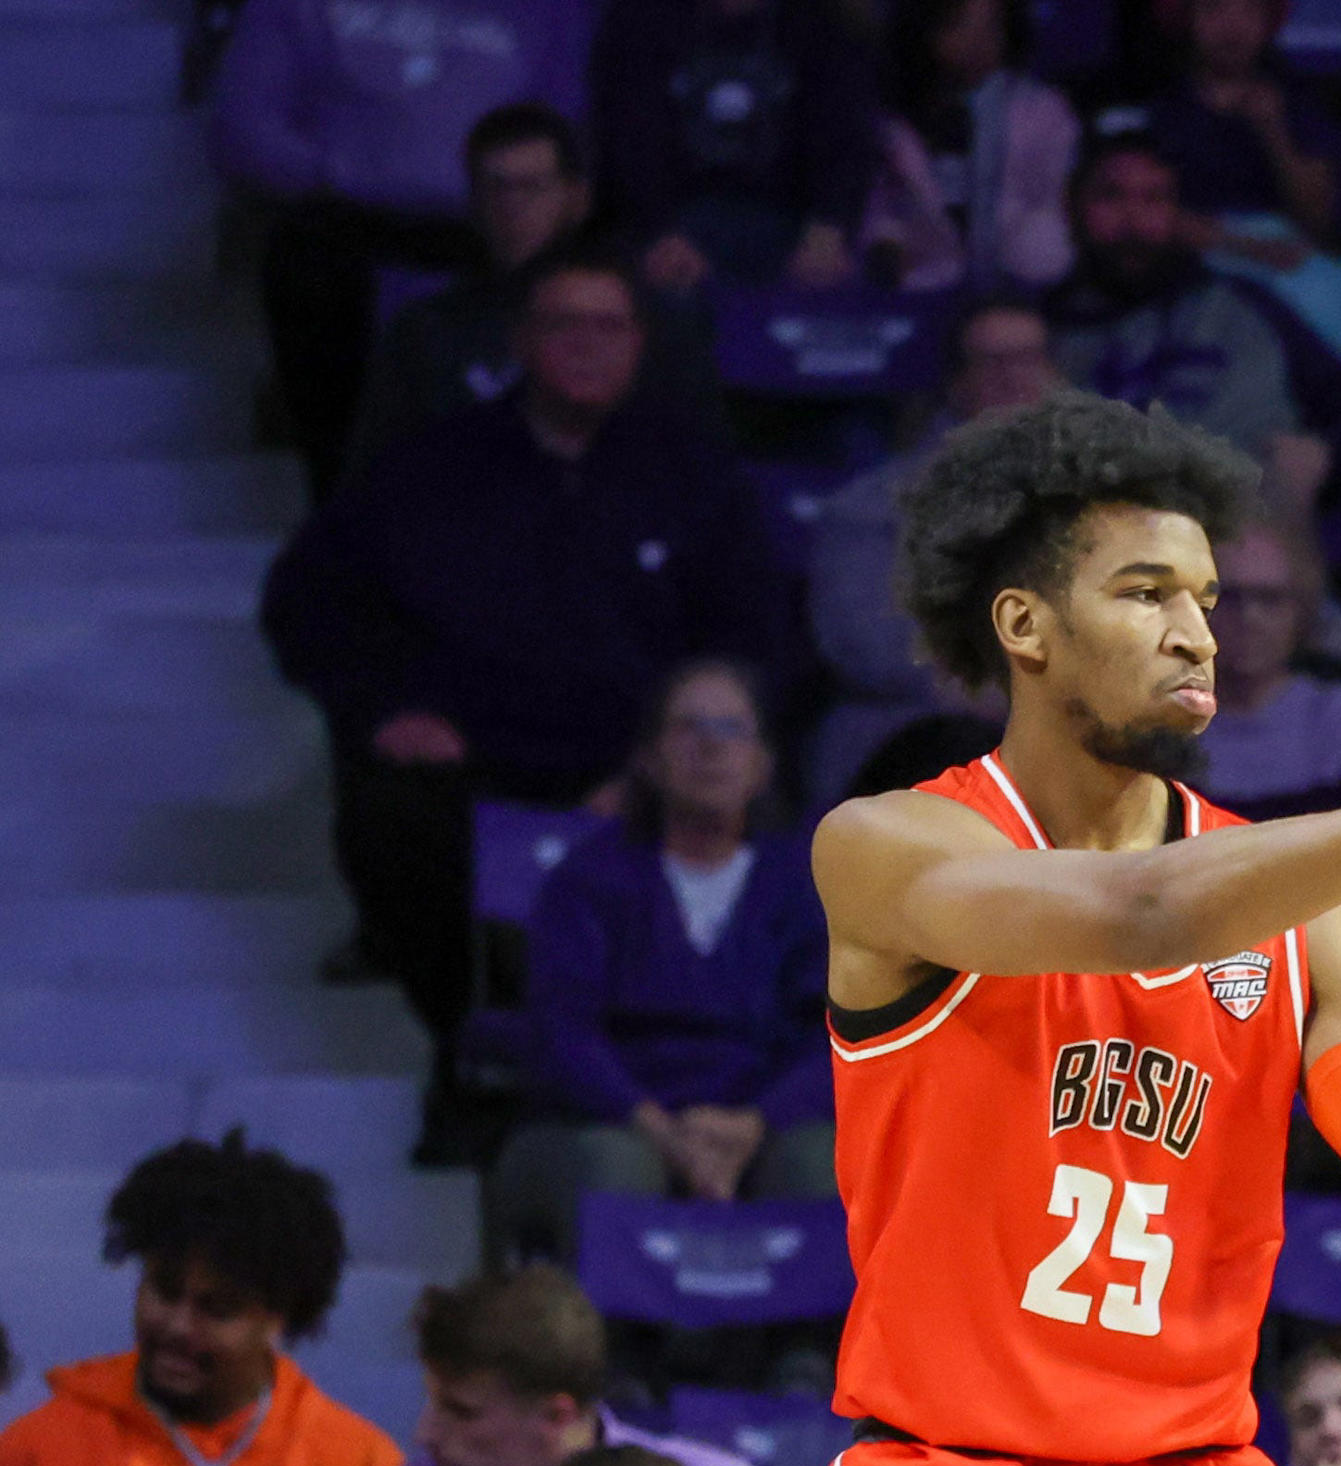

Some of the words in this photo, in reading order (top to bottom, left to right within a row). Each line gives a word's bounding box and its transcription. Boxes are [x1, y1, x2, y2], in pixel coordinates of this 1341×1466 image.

[1212, 979, 1268, 999] MAC
[1050, 1038, 1212, 1158] BGSU
[1020, 1163, 1175, 1337] 25
